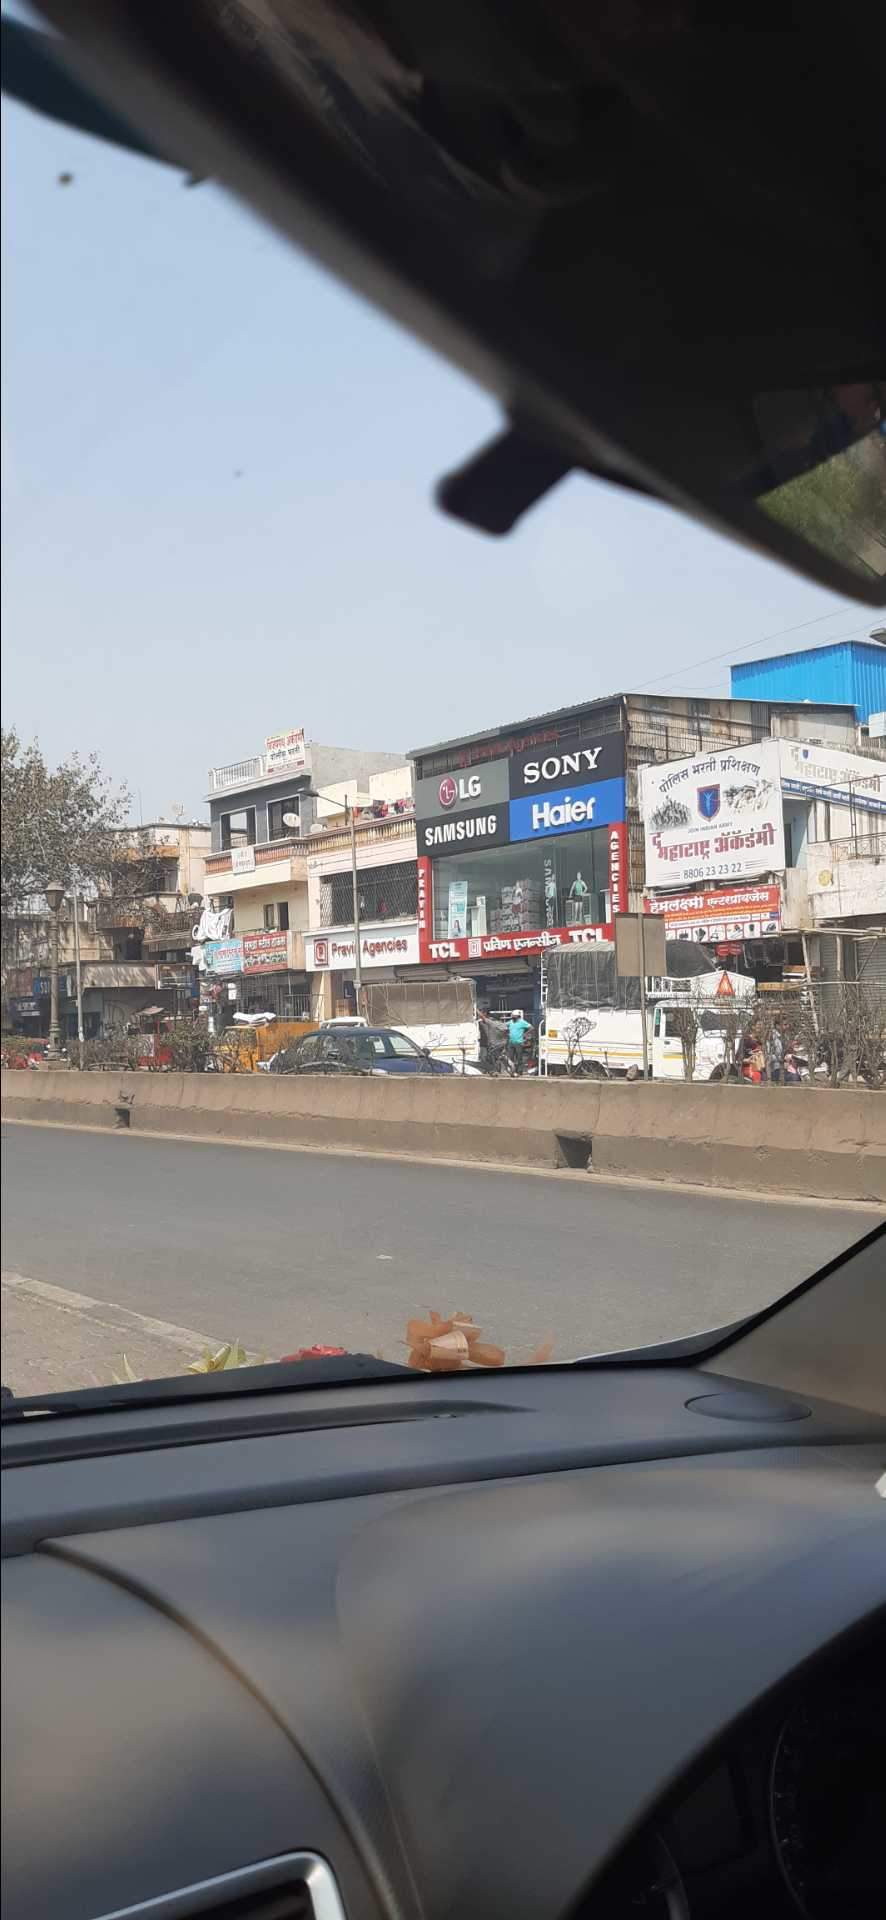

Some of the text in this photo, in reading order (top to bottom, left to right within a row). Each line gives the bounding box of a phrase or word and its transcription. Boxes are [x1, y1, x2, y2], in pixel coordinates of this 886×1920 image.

[523, 747, 602, 784] SONY
[692, 757, 716, 775] भरती
[720, 755, 760, 776] प्रशिक्षण
[459, 776, 481, 799] LG
[532, 796, 596, 830] Haier
[425, 815, 497, 846] SAMSUNG
[610, 830, 620, 913] AGENCIES
[684, 862, 741, 879] 8806 23 23 22
[569, 928, 609, 943] TCL
[331, 937, 408, 958] Pravi Agencies
[428, 942, 460, 959] TCL
